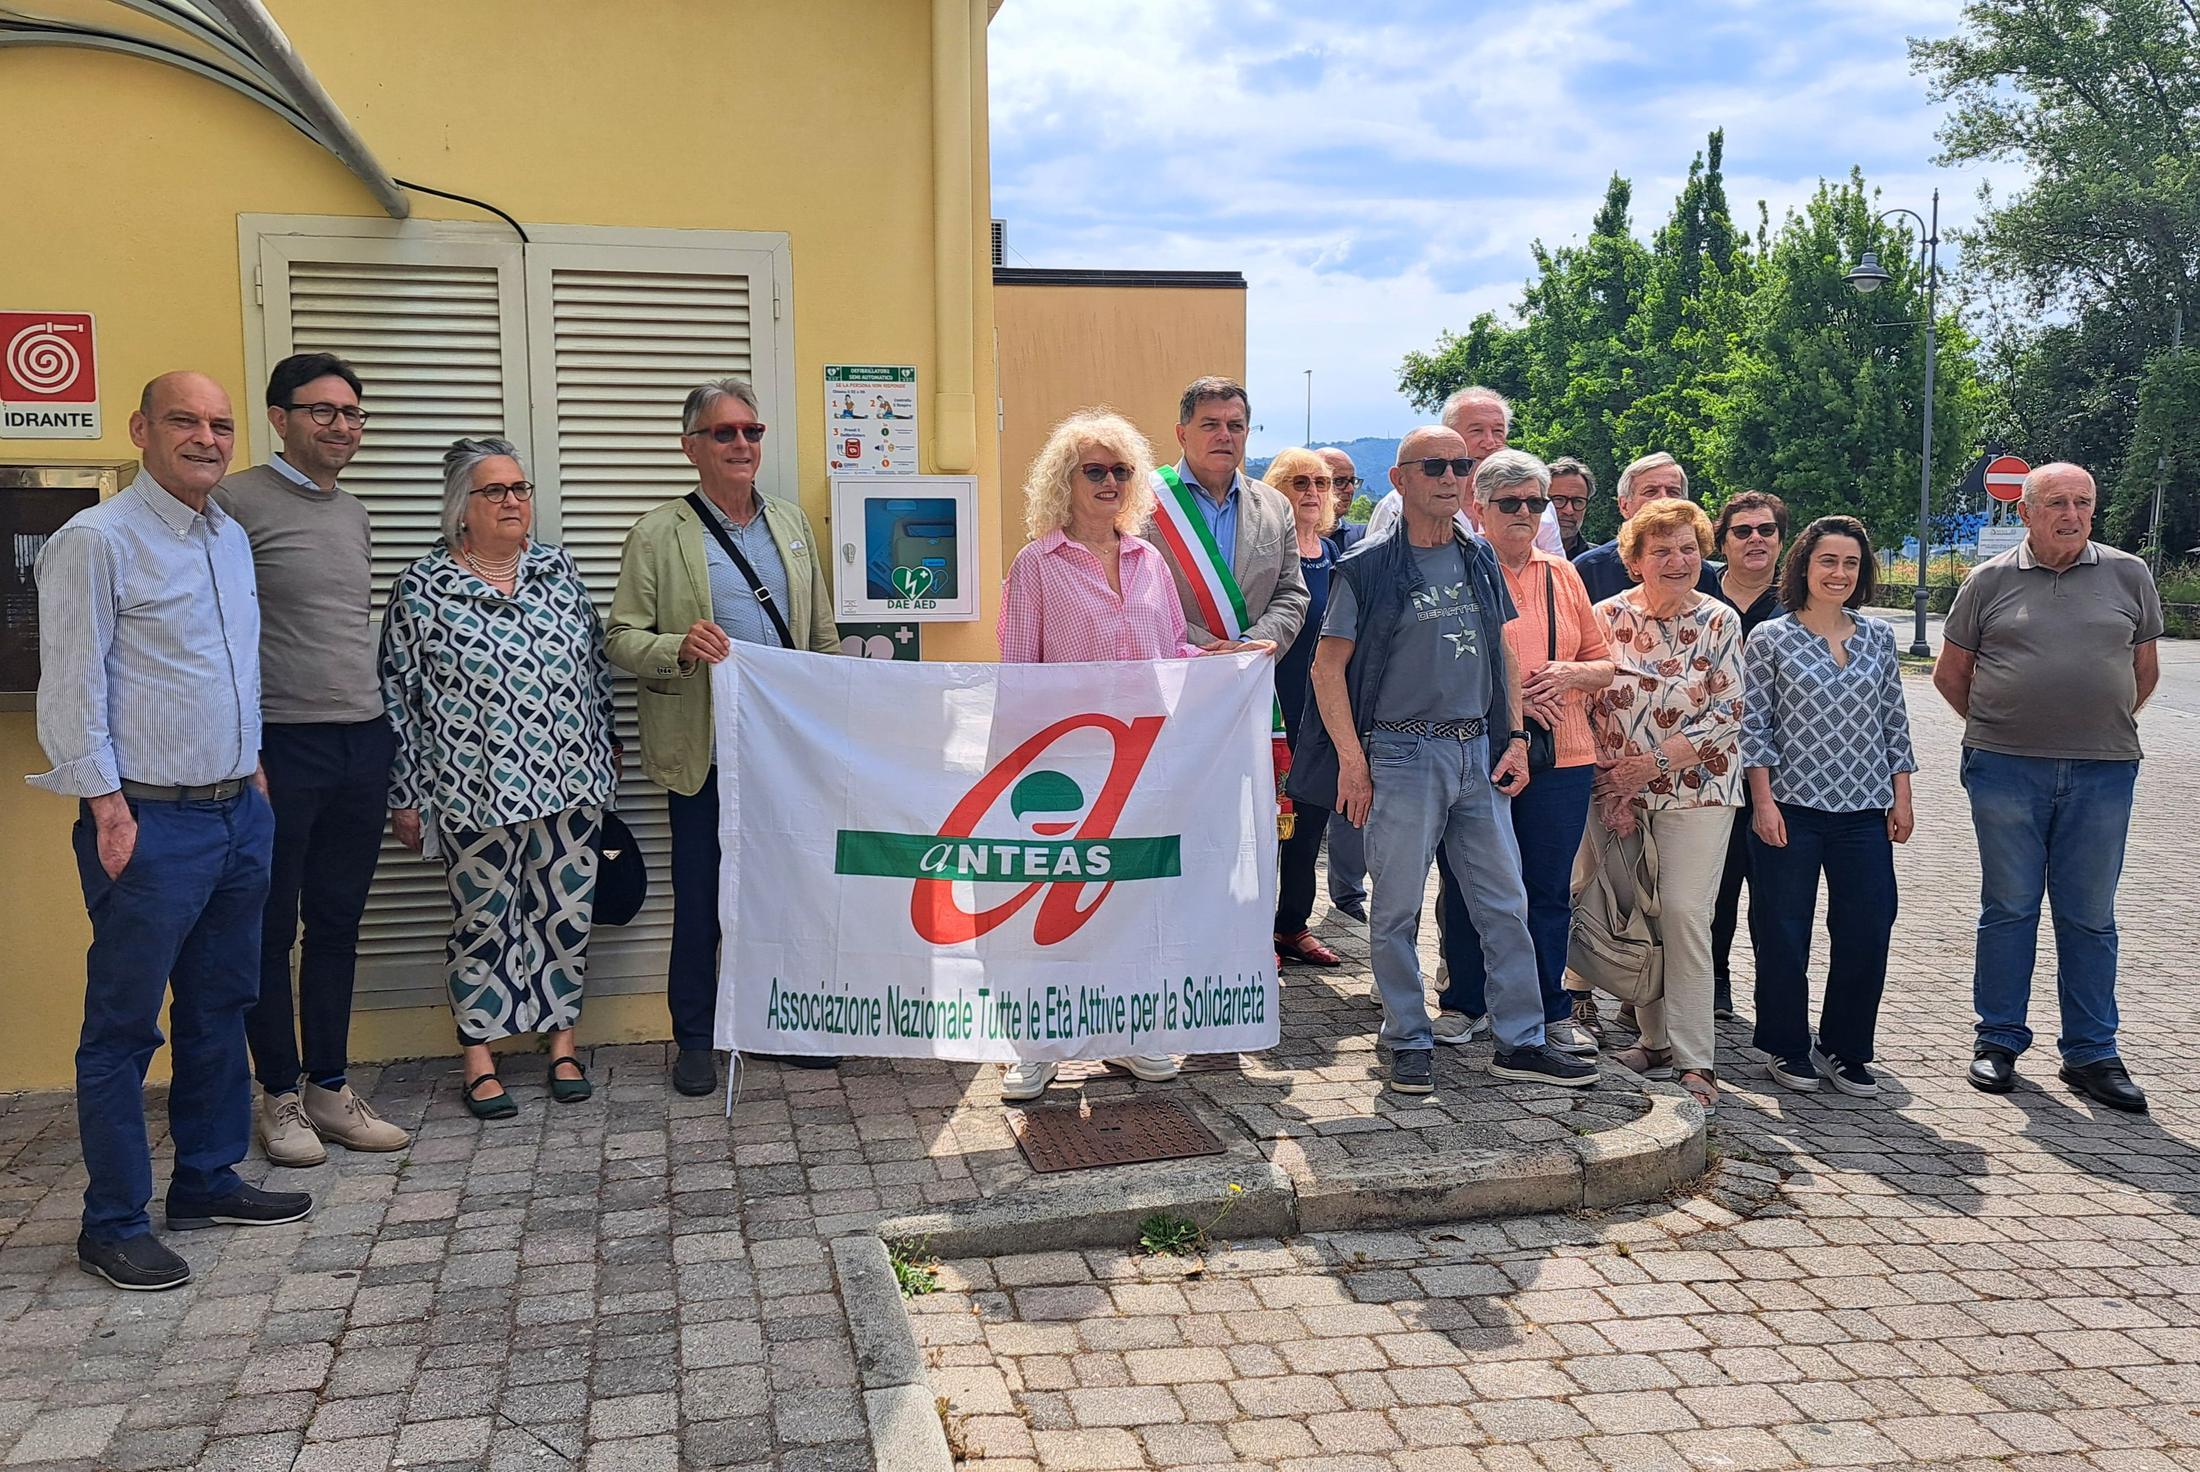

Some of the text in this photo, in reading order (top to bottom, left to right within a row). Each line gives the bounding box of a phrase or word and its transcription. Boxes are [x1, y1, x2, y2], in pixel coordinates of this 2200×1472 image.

[4, 412, 94, 427] IDRANTE
[832, 428, 839, 436] 3
[887, 599, 937, 610] DAE AED
[767, 971, 1265, 1046] Associazione Nazionale Tutte le Età Attive per la Solidarietà
